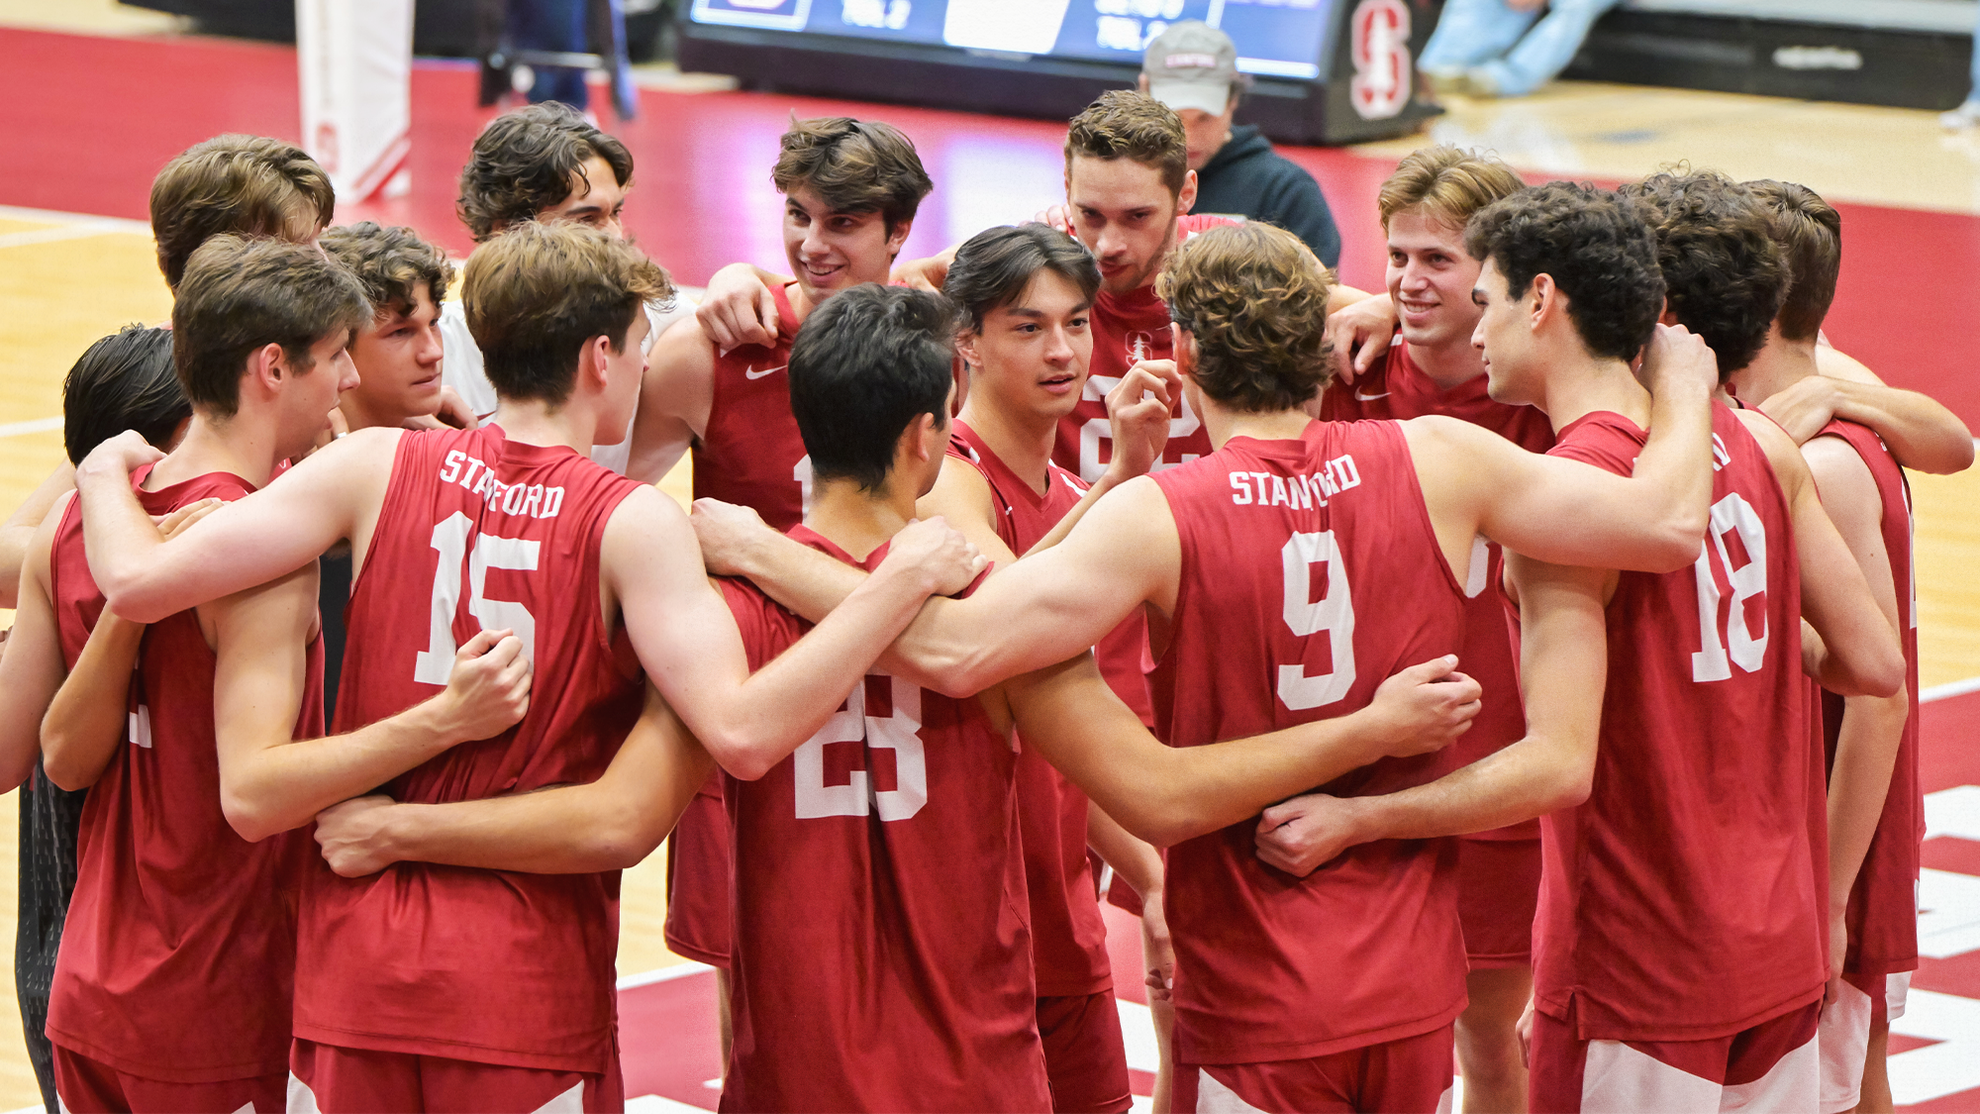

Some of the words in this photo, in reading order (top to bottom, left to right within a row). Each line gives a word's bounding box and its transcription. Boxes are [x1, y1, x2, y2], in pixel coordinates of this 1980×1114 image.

[439, 449, 565, 519] STAFORD
[1228, 453, 1361, 511] STANORD
[414, 510, 541, 686] 15
[1277, 529, 1356, 711] 9
[1692, 491, 1769, 683] 18
